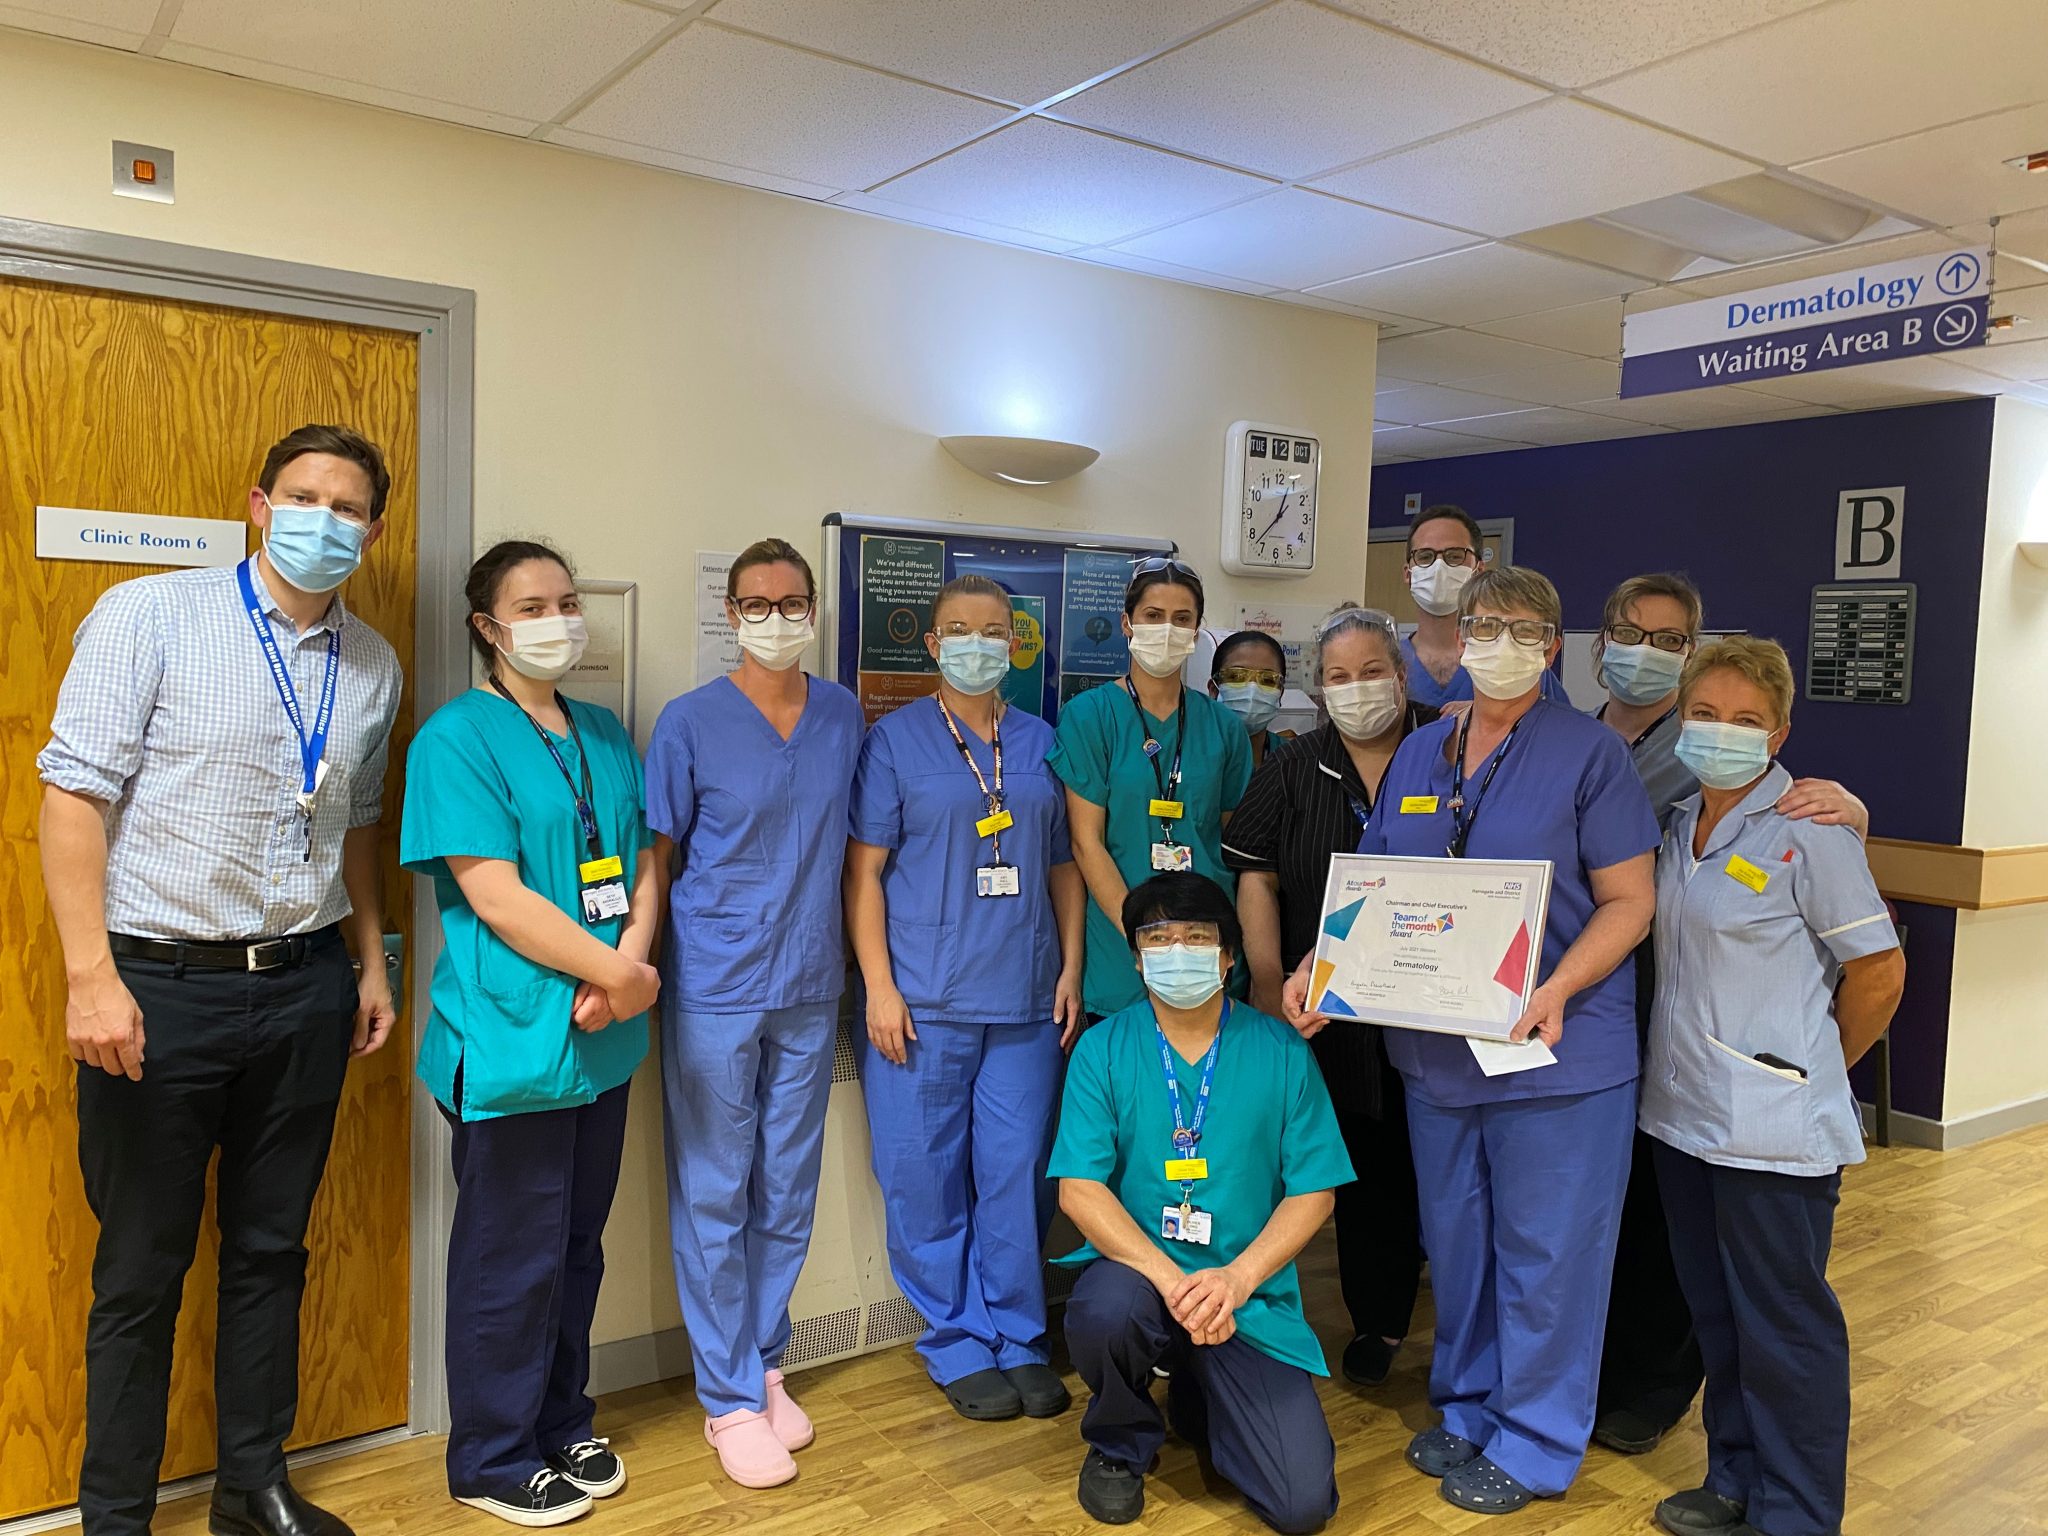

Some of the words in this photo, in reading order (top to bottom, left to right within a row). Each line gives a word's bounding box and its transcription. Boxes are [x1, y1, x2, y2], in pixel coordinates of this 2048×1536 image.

[1727, 276, 1924, 329] Dermatology
[1698, 341, 1808, 378] Waiting
[1817, 330, 1889, 360] Area
[1902, 317, 1922, 346] B
[1251, 440, 1264, 452] TUE
[1273, 441, 1288, 457] 12
[1295, 445, 1308, 458] OCT
[1262, 477, 1270, 489] 11
[1275, 473, 1284, 486] 12
[1251, 490, 1261, 502] 10
[1300, 495, 1305, 506] 2
[1246, 508, 1252, 520] 9
[1302, 514, 1308, 524] 3
[1250, 528, 1256, 540] 8
[1298, 532, 1304, 543] 4
[1843, 496, 1895, 568] B
[80, 529, 134, 545] Clinic
[140, 532, 190, 549] Room
[197, 536, 207, 550] 6
[1260, 542, 1266, 554] 7
[1272, 548, 1278, 560] 6
[1286, 544, 1292, 556] 5
[896, 560, 904, 568] all
[868, 568, 891, 577] Accept
[1083, 570, 1097, 578] None
[869, 586, 892, 596] wishing
[894, 588, 906, 596] you
[1014, 619, 1031, 628] YOU
[1283, 644, 1302, 656] Point
[330, 656, 338, 676] Chief
[264, 642, 280, 664] Chief
[273, 662, 292, 702] Operating
[288, 702, 302, 730] Officer
[322, 674, 335, 710] Operating
[869, 694, 894, 702] Regular
[316, 710, 329, 736] Officer
[1504, 882, 1521, 890] NHS
[1390, 930, 1413, 938] Award
[1394, 960, 1438, 972] Dermatology
